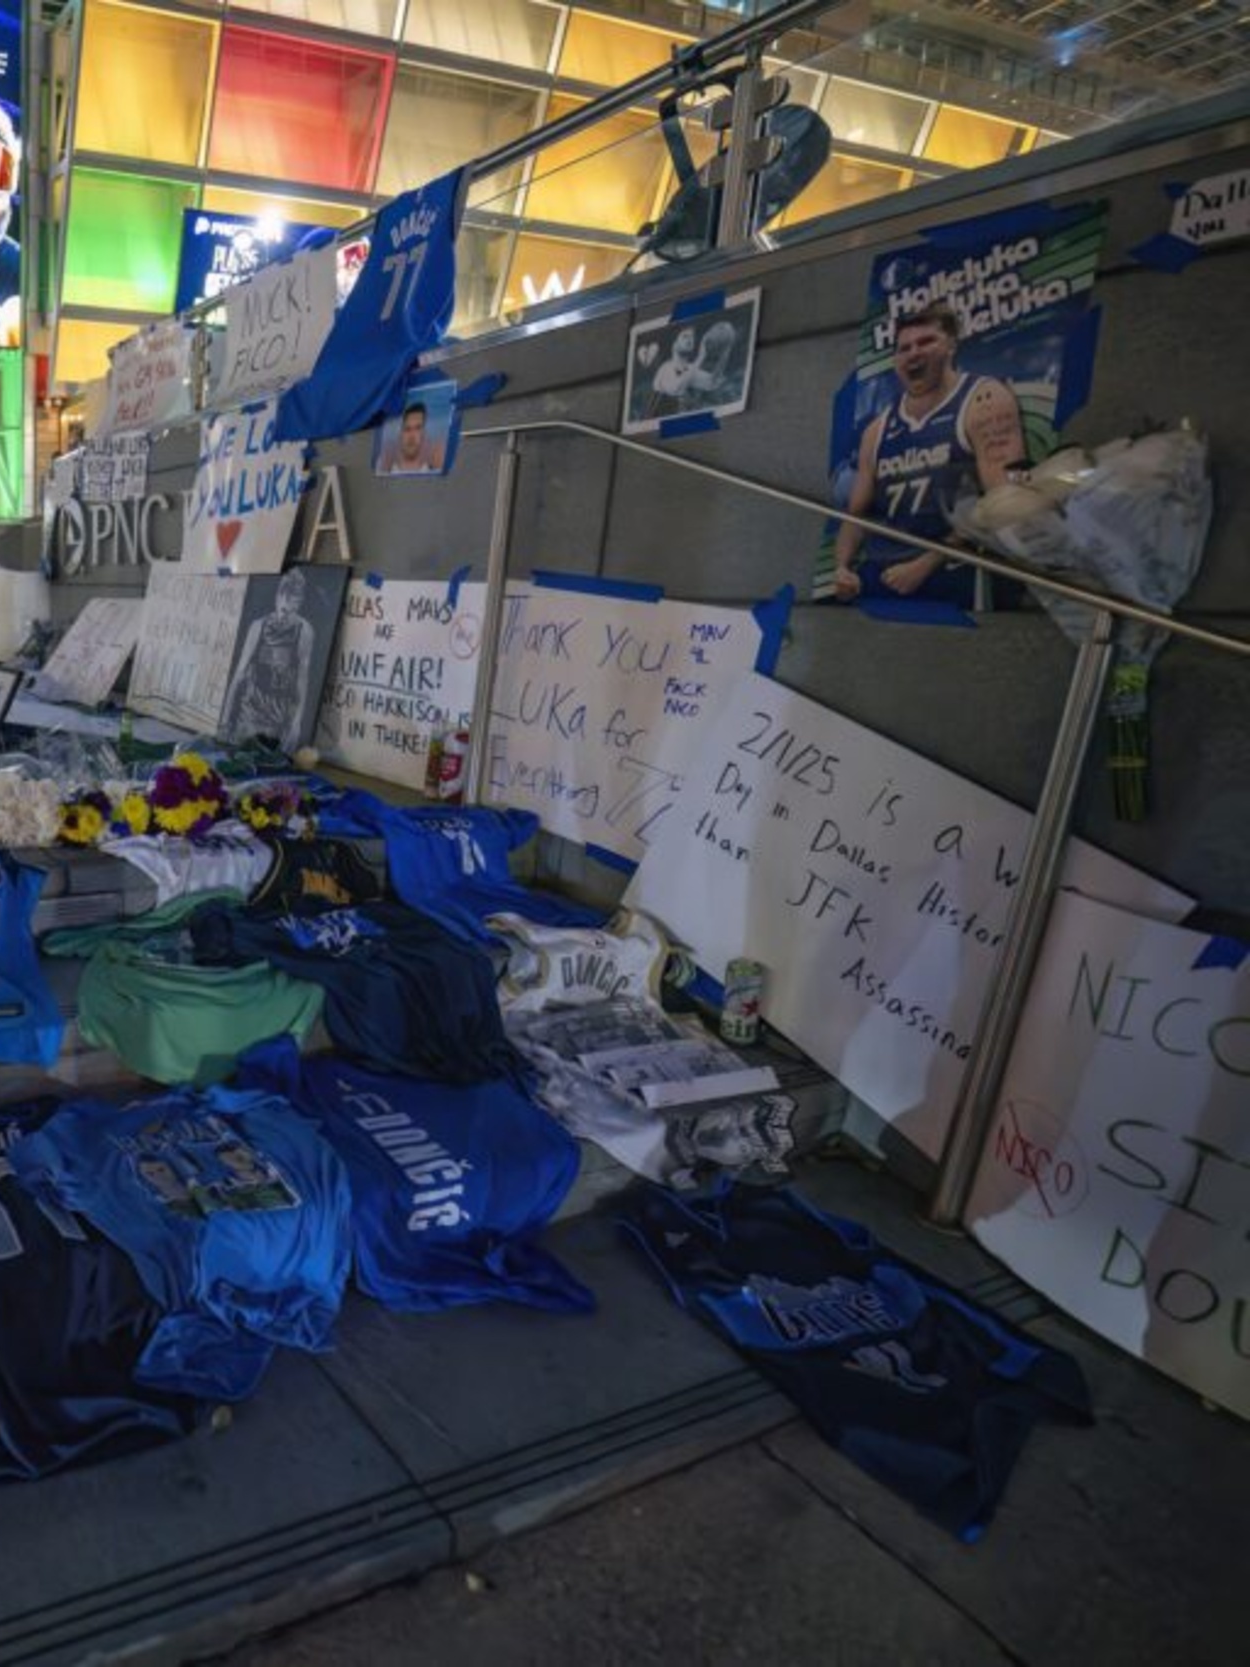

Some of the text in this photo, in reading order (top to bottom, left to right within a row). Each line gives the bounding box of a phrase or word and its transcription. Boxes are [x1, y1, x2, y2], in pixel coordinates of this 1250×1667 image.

[1183, 178, 1250, 218] Dall
[237, 463, 302, 516] LUKA
[886, 477, 932, 518] 77
[90, 494, 169, 567] PNC
[348, 595, 452, 625] LLAS MAVS
[690, 623, 731, 642] MAV
[340, 650, 444, 691] UNFAIR!
[604, 708, 646, 750] for
[736, 711, 843, 798] 2/1/25
[867, 779, 901, 827] is
[934, 825, 964, 857] a
[694, 811, 752, 862] than
[714, 763, 752, 811] Day
[810, 819, 892, 883] Dallas
[917, 880, 1006, 950] Histor
[785, 872, 874, 942] JFK
[842, 957, 974, 1062] Assassina
[1065, 951, 1250, 1078] NICO
